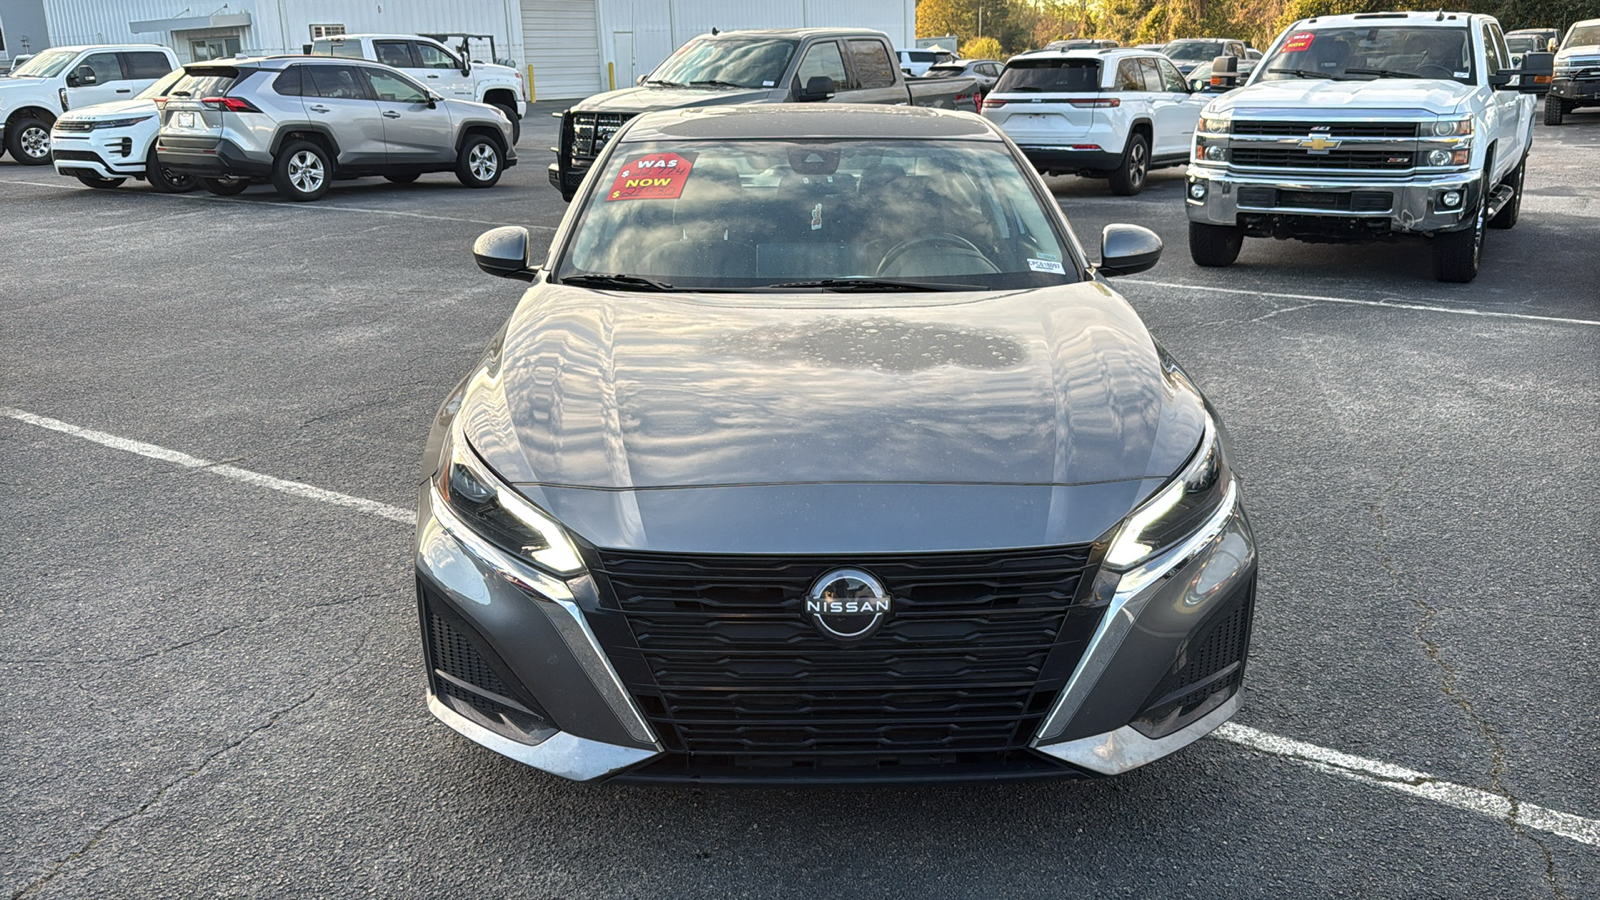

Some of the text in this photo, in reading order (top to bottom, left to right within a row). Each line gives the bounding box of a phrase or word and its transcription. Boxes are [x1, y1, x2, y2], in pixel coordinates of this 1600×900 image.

[638, 159, 679, 169] WAS
[625, 178, 672, 188] NOW
[807, 600, 889, 613] NISSAN
